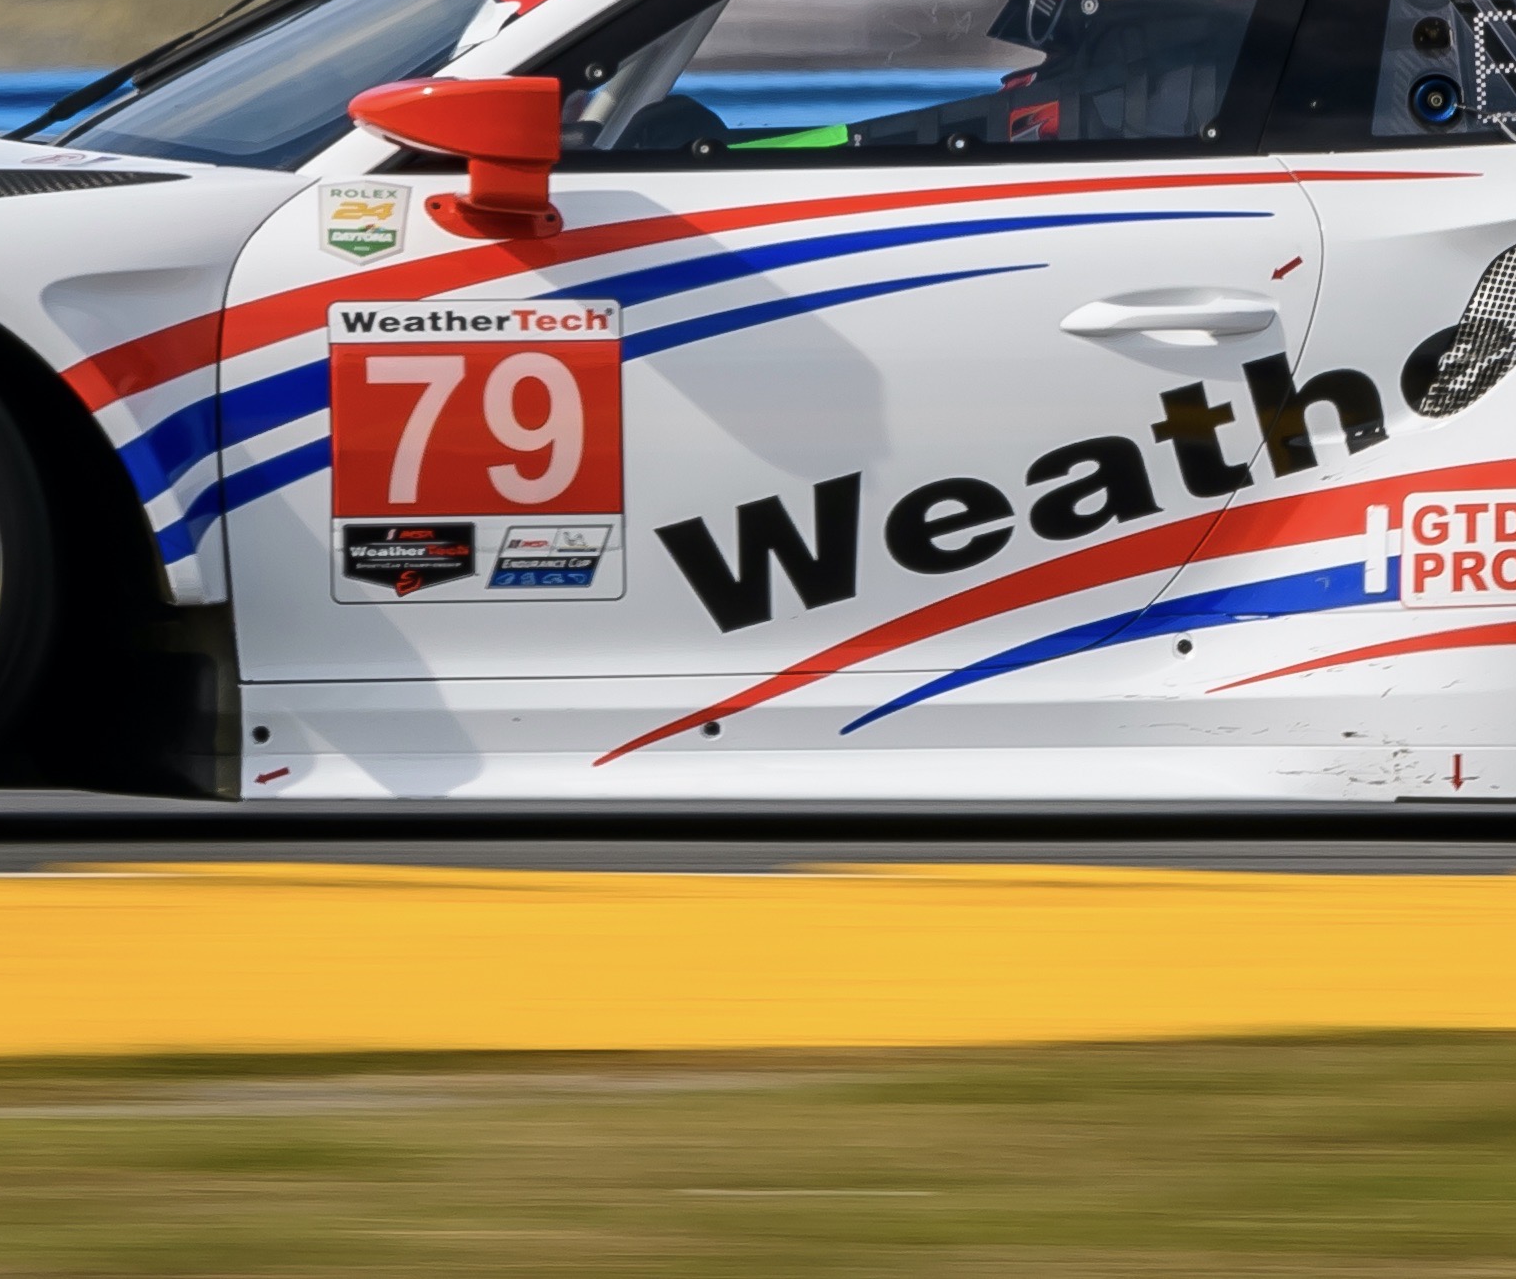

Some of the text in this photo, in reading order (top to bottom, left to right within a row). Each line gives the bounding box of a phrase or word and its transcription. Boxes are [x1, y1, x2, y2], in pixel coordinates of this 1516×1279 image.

[330, 188, 398, 199] ROLEX
[331, 201, 396, 220] 24
[365, 351, 584, 505] 79
[349, 544, 470, 558] WeatherTech
